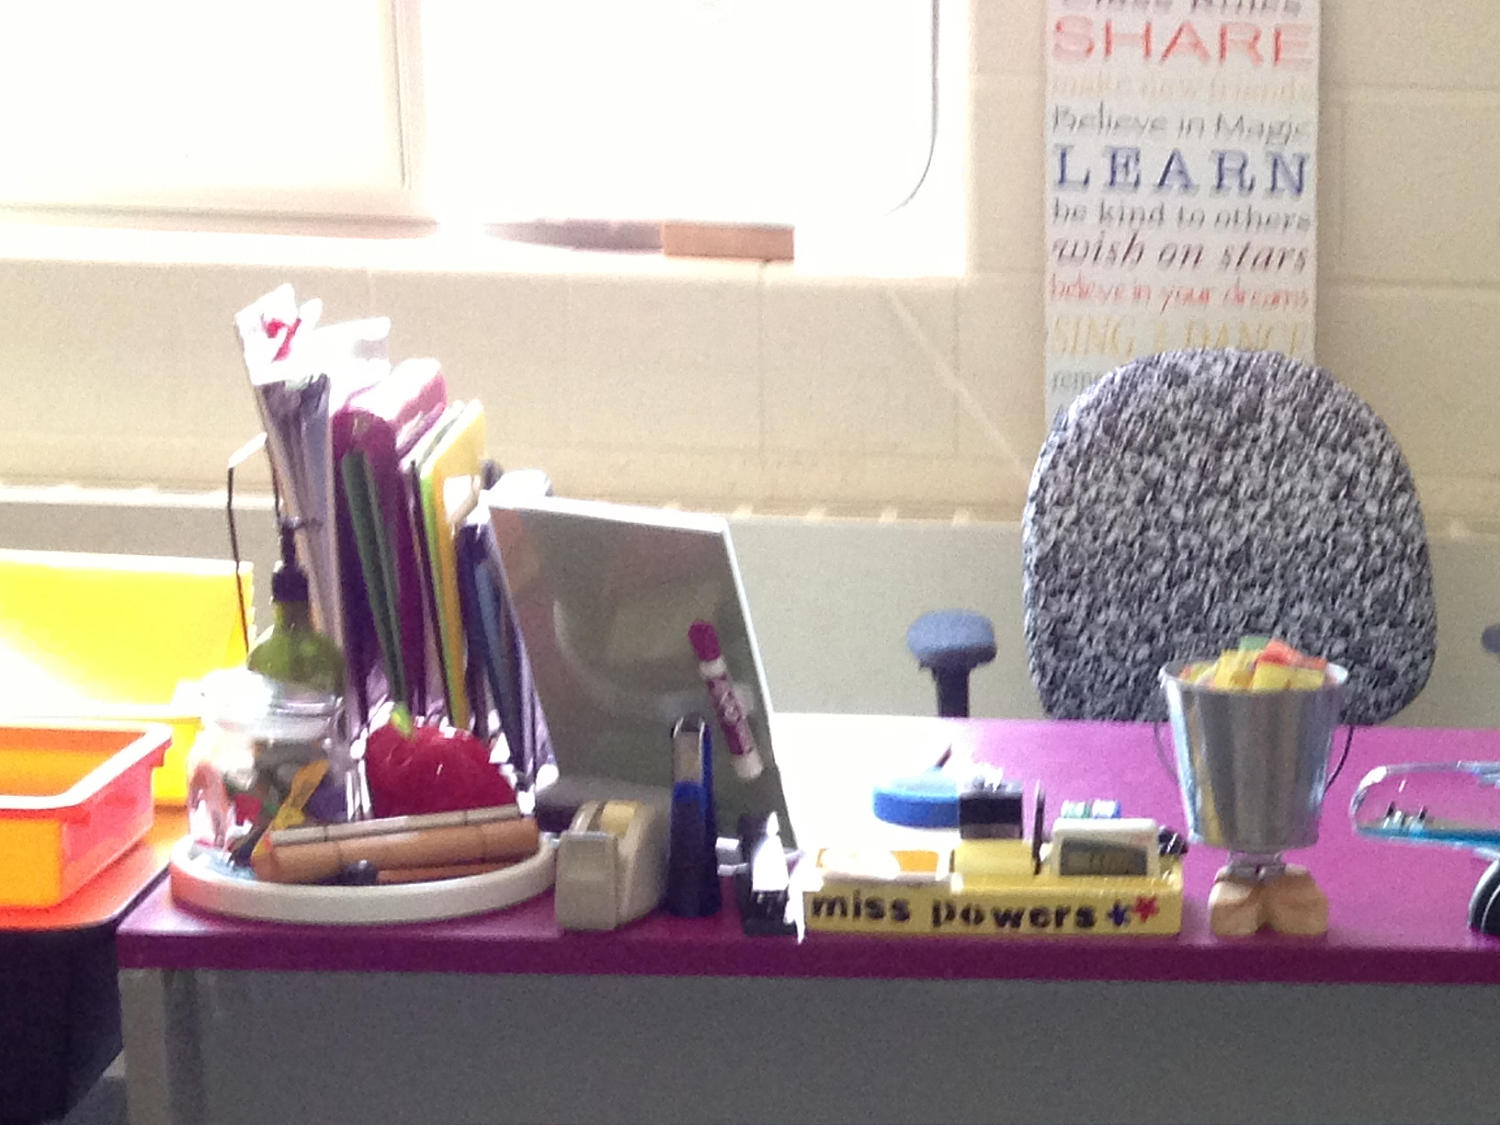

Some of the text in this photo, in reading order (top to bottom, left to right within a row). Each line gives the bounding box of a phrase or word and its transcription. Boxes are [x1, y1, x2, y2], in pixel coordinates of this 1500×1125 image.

[1051, 14, 1314, 68] SHARE
[1051, 100, 1168, 137] Believe
[1176, 114, 1206, 140] in
[1053, 143, 1311, 201] LEARN
[1100, 199, 1166, 232] kind
[1052, 229, 1307, 274] wish on stars
[811, 890, 1097, 931] miss powers
